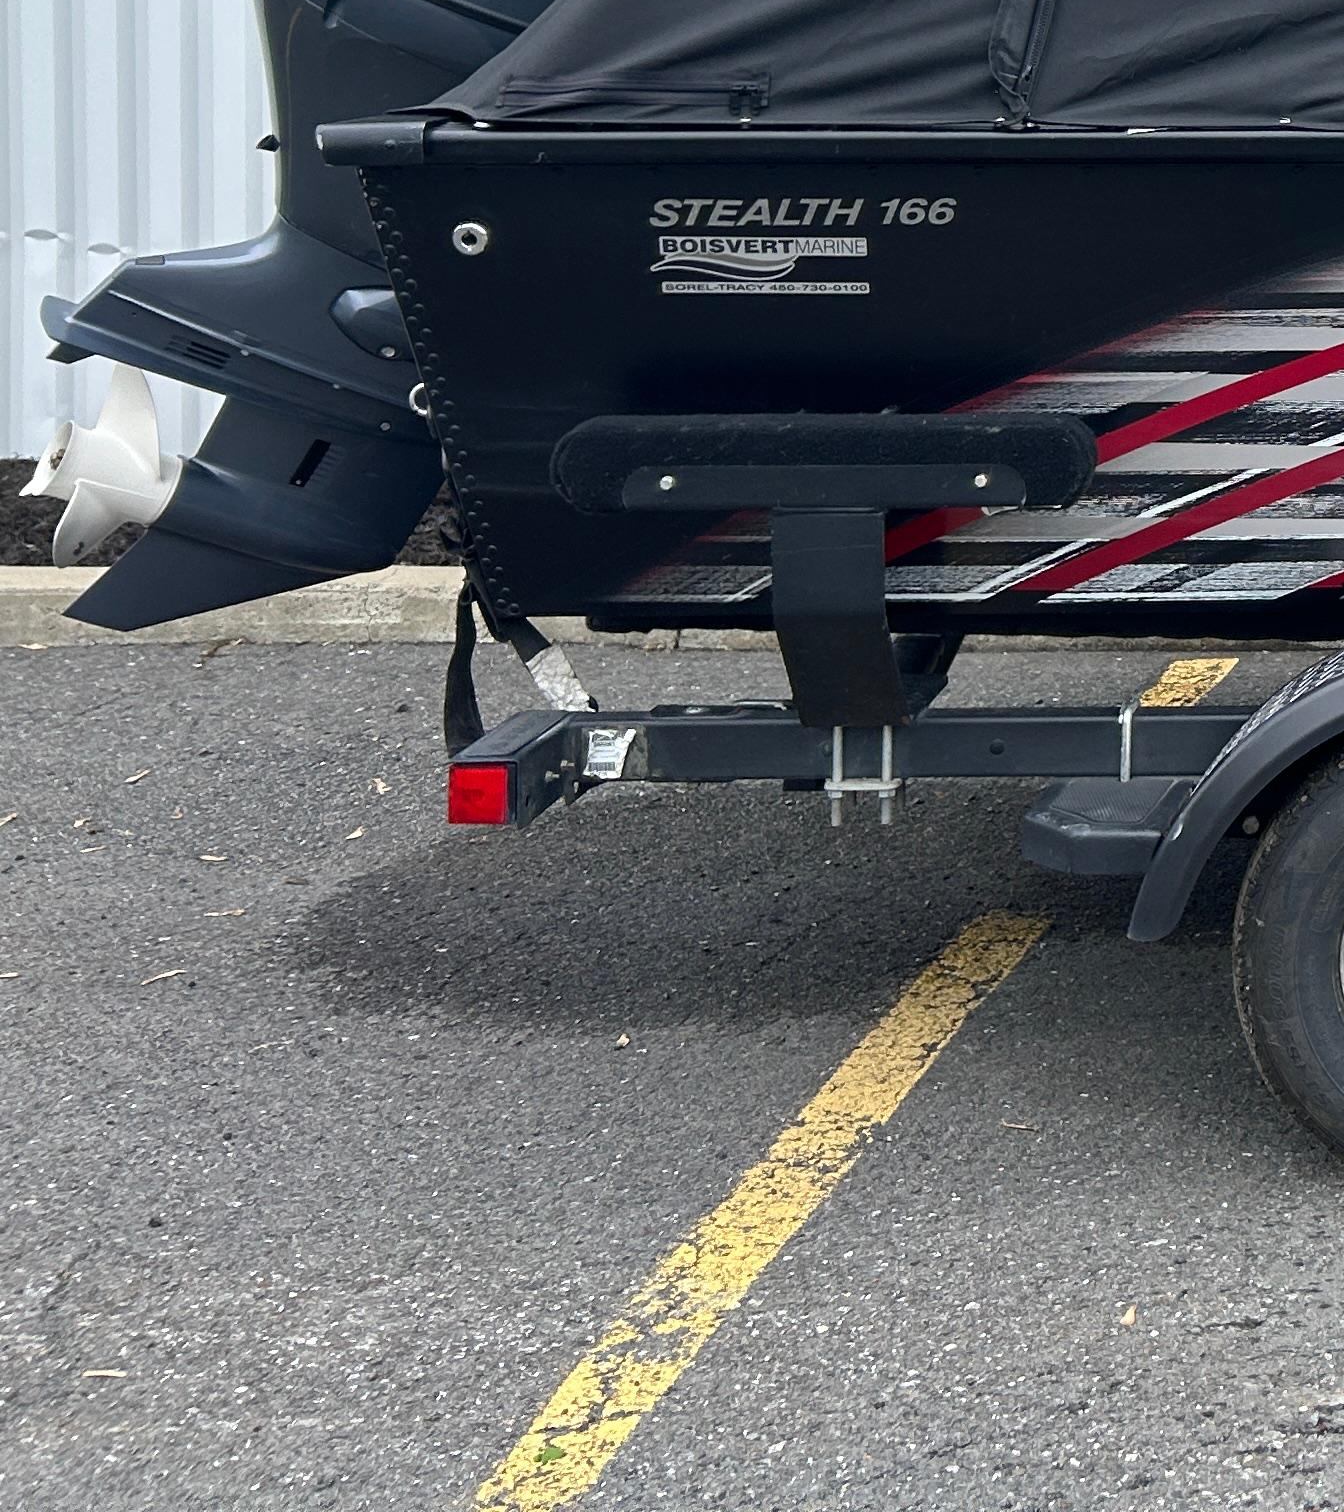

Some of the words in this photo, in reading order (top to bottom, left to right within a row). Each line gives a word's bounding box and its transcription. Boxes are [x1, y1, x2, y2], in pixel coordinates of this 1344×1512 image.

[650, 198, 864, 227] STEALTH
[880, 197, 958, 226] 166
[665, 283, 765, 292] SOREL-TRACY
